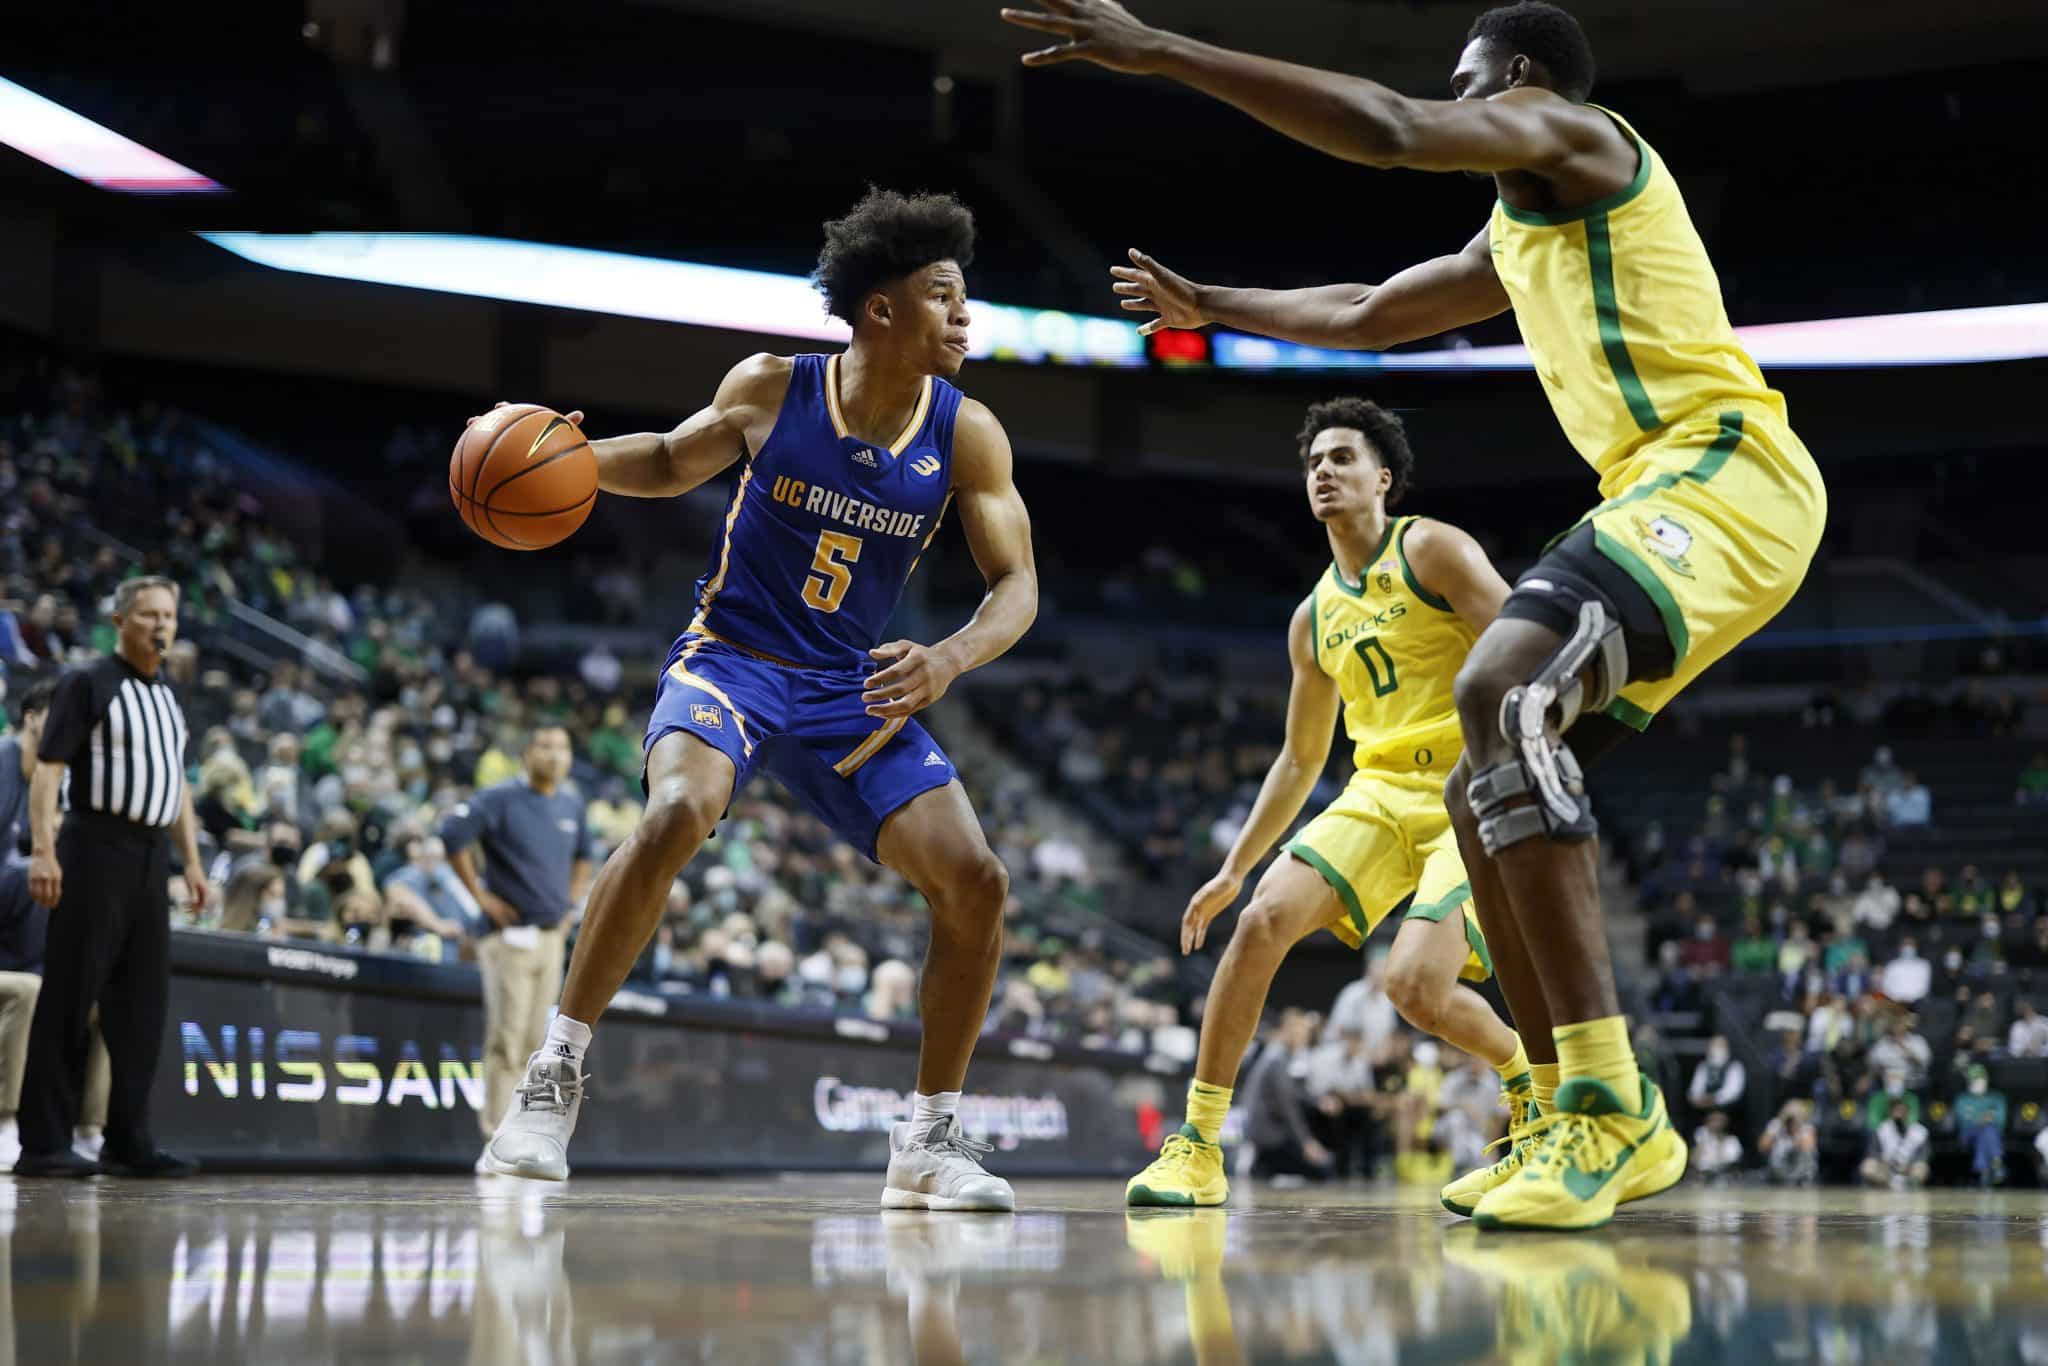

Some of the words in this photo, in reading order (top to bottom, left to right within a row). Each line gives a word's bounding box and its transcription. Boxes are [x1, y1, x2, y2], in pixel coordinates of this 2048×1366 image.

[772, 475, 806, 508] UC
[805, 485, 925, 538] RIVERSIDE
[801, 528, 864, 614] 5
[1325, 602, 1408, 650] DUCKS
[180, 1020, 486, 1111] NISSAN
